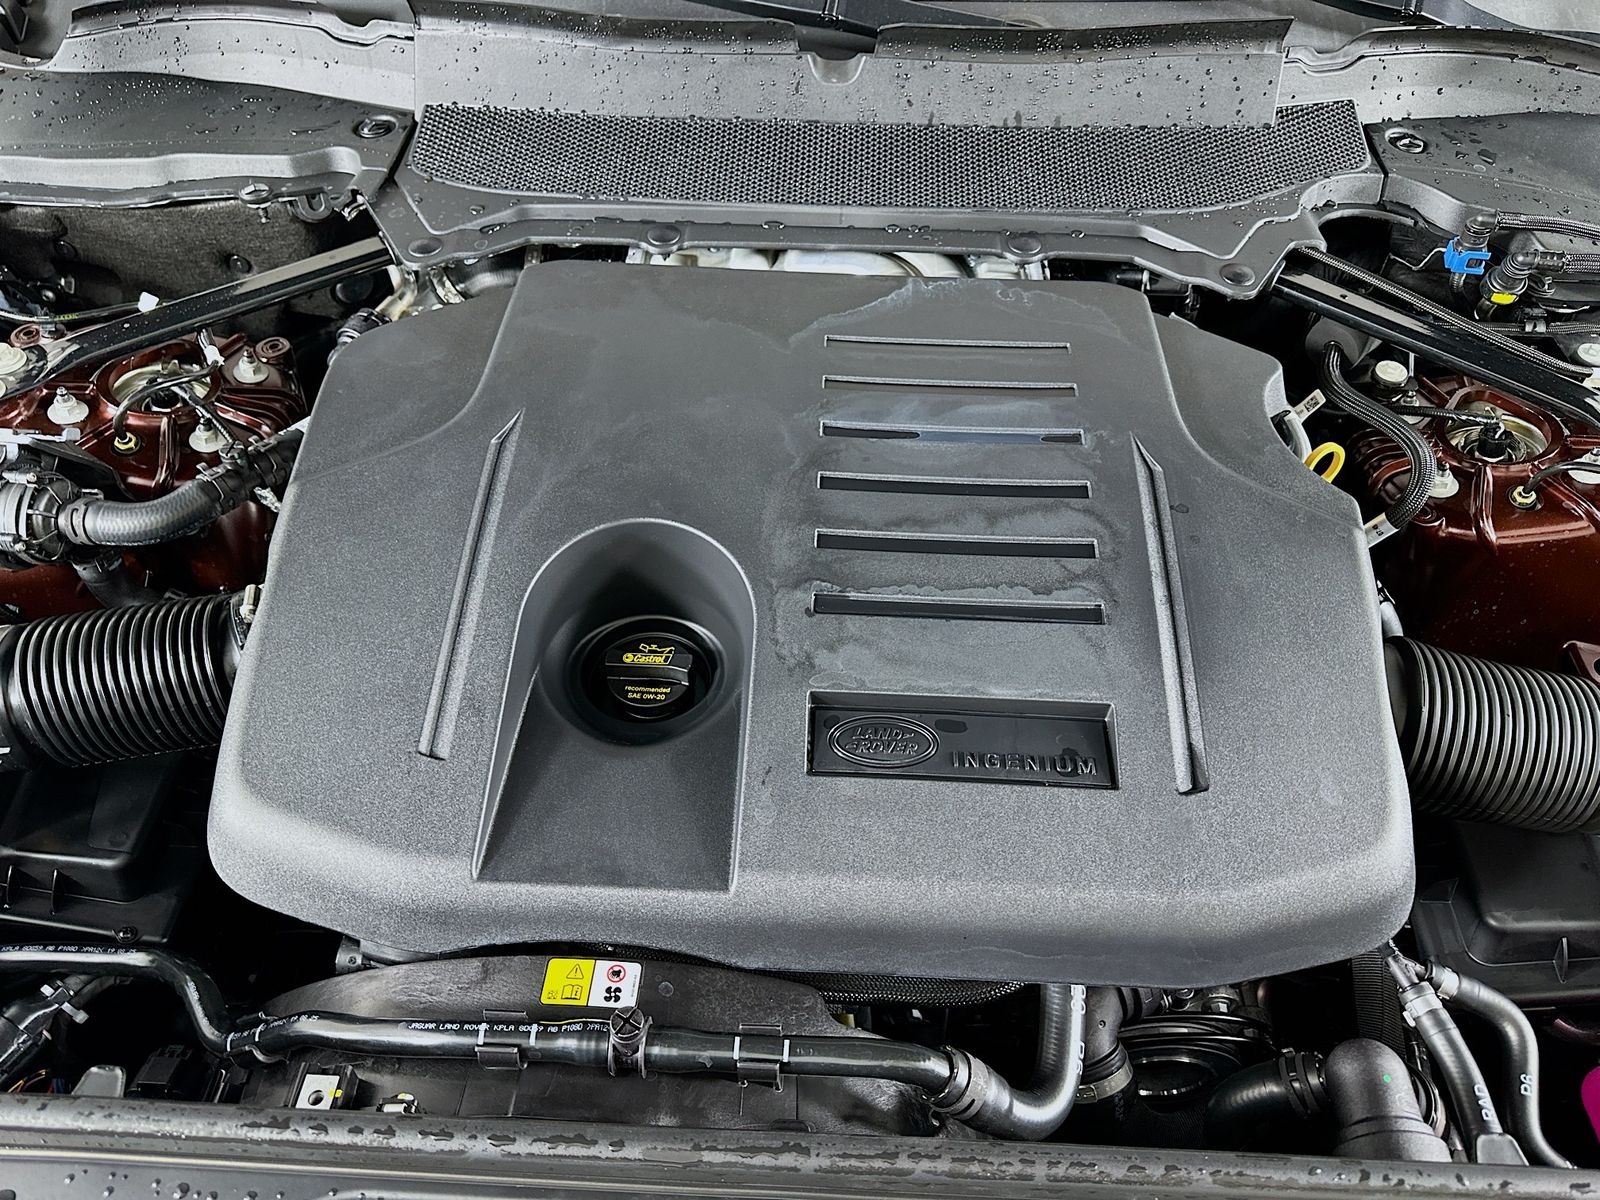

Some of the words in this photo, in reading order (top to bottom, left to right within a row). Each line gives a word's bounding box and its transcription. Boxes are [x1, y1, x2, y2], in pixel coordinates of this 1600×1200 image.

[633, 653, 666, 664] Castrol
[624, 685, 671, 694] recommended
[642, 692, 666, 700] 0W-20
[849, 741, 919, 755] ROVER
[951, 751, 1098, 776] INGENIUM
[408, 1022, 437, 1030] JAGUAR
[493, 1023, 515, 1031] KPLA
[547, 1025, 559, 1033] AB
[1473, 1084, 1496, 1122] RAD
